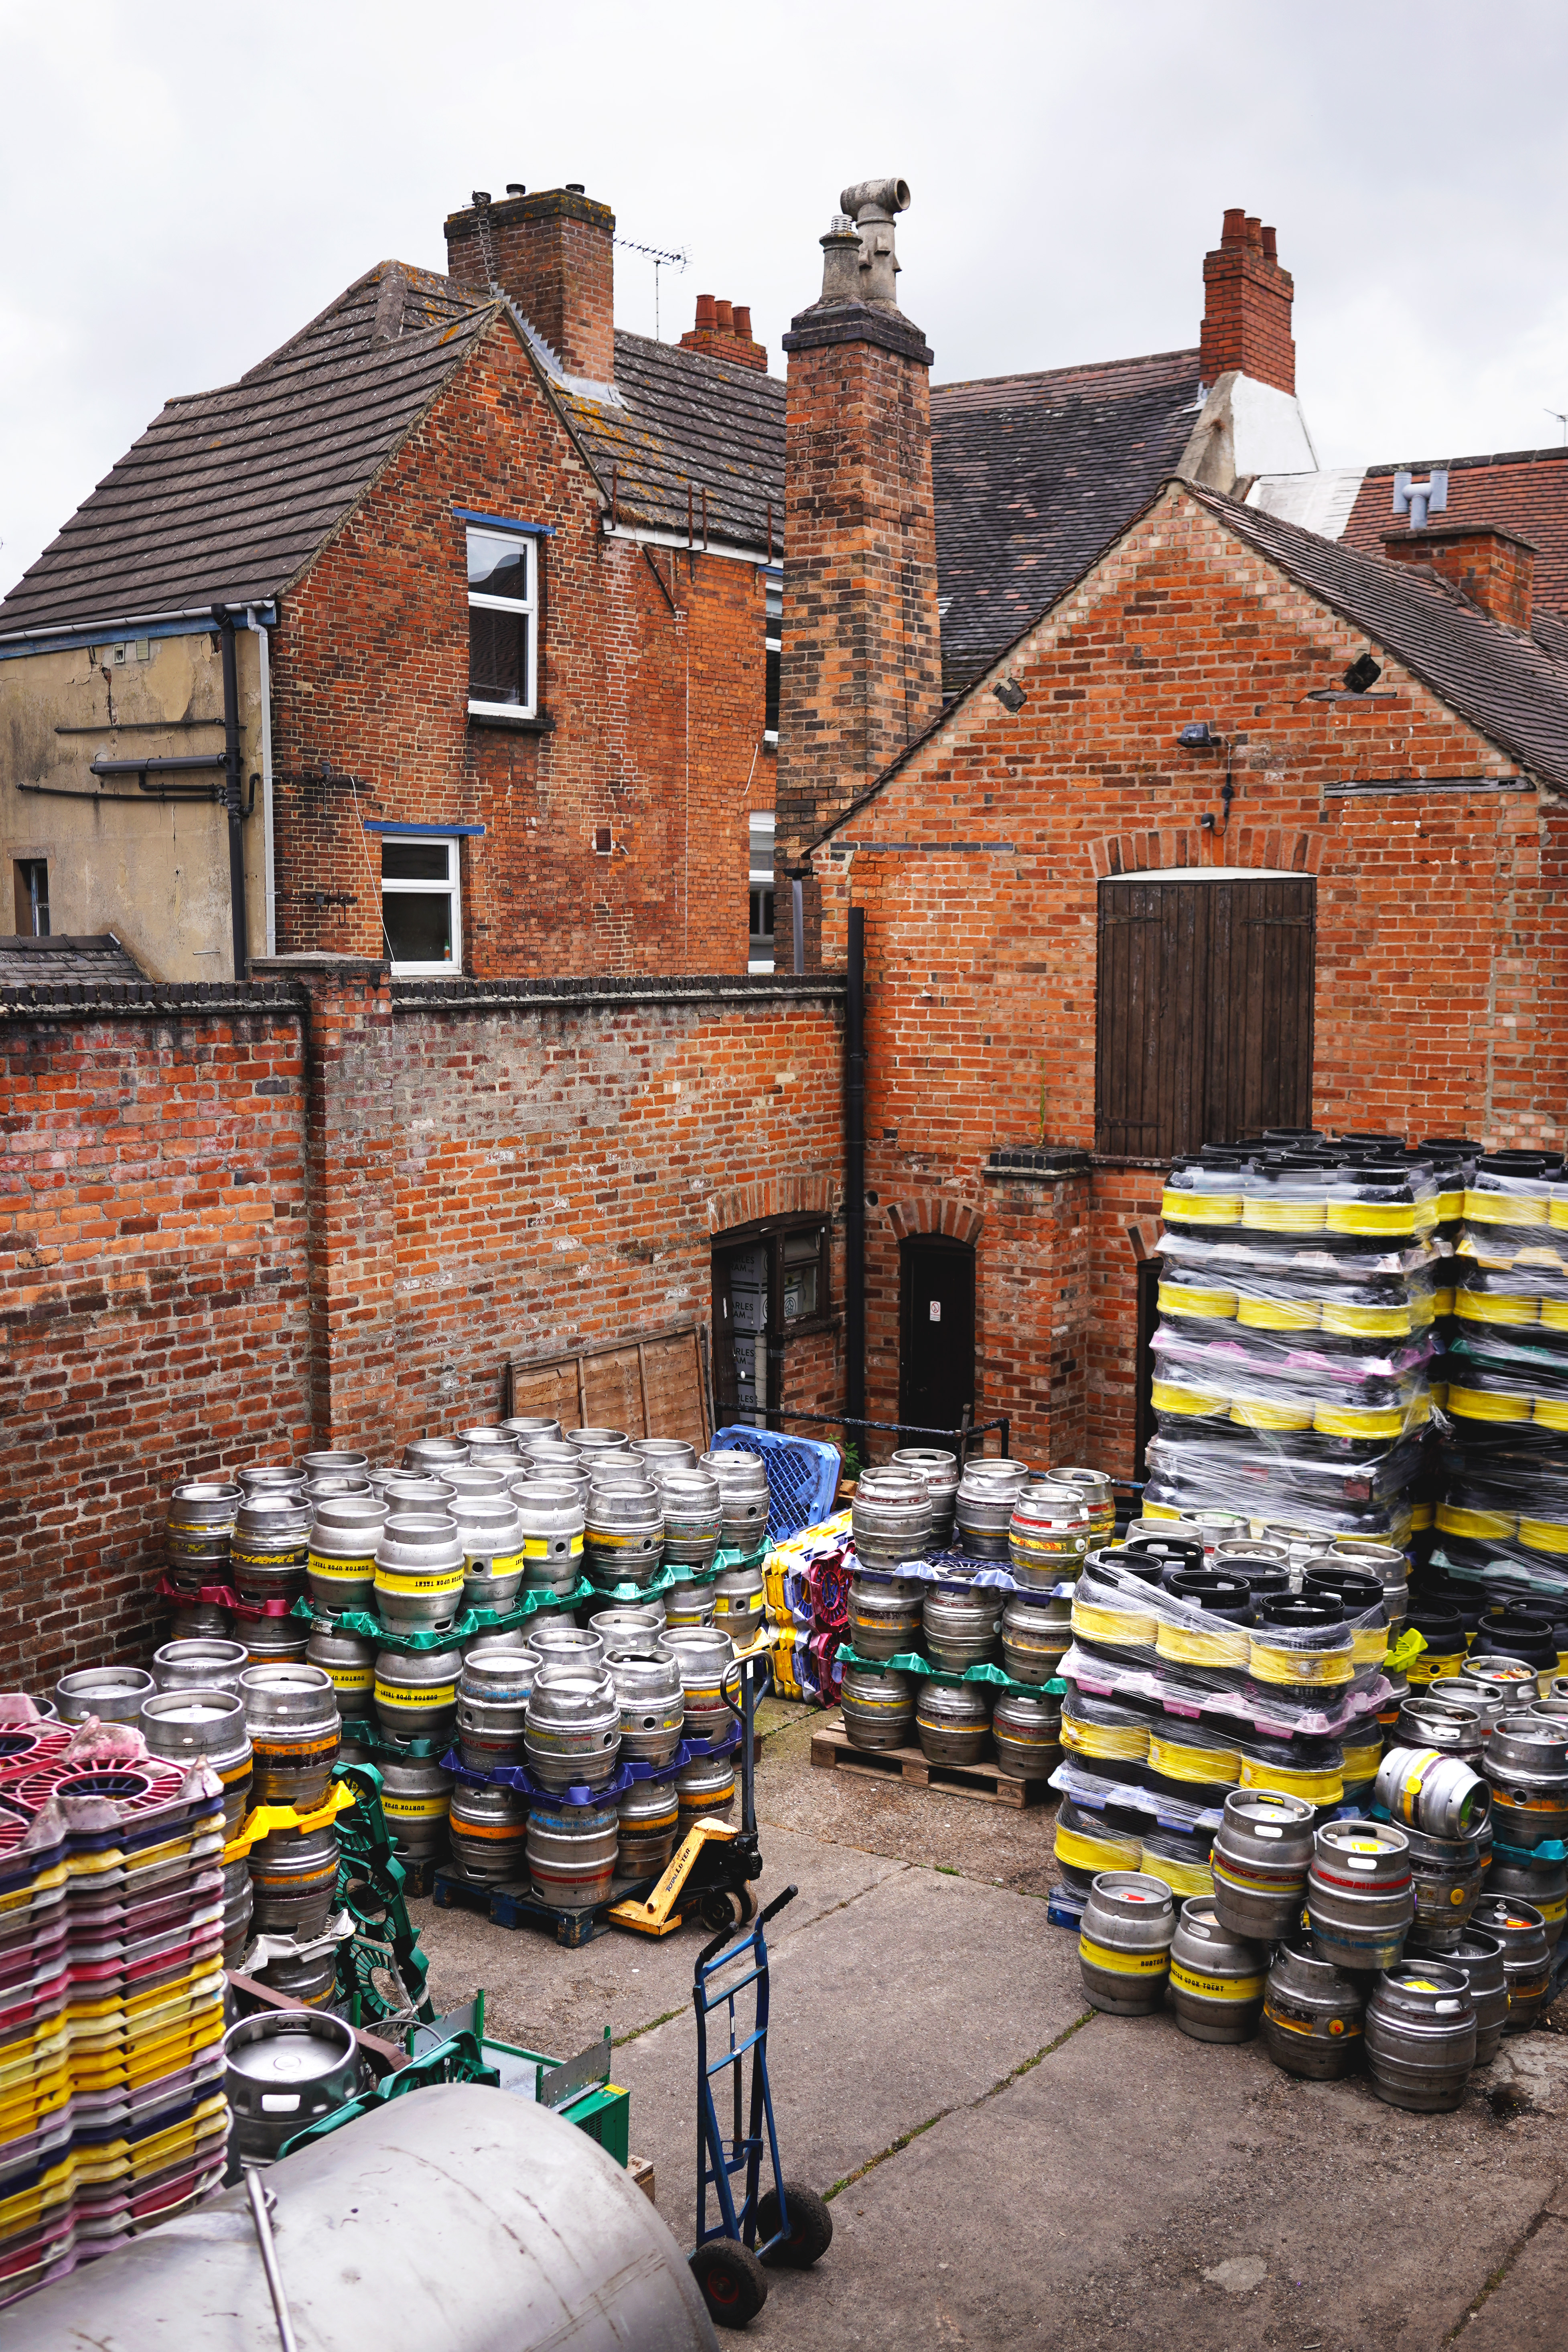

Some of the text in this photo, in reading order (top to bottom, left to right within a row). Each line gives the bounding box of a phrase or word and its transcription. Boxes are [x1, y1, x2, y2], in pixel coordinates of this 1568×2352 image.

[313, 1560, 326, 1569] TRENT
[380, 1689, 394, 1699] TRENT
[385, 1801, 398, 1810] UPON
[1140, 1958, 1163, 1967] BURTON
[1185, 1977, 1200, 1987] UPON
[1203, 1983, 1225, 1992] TRENT
